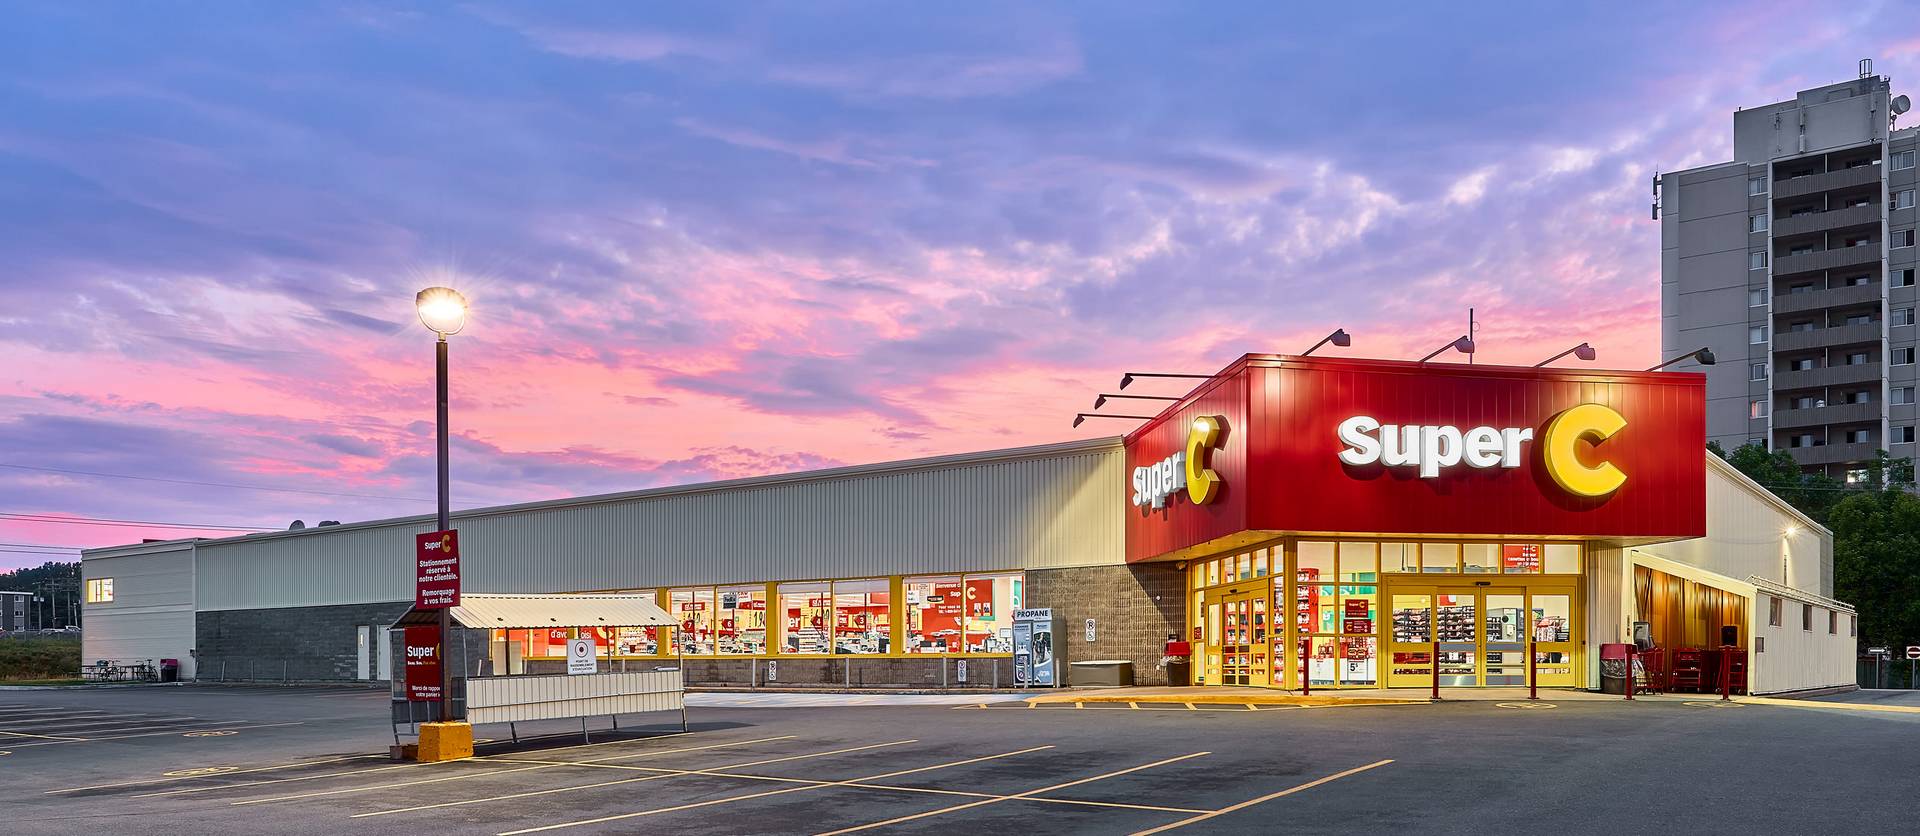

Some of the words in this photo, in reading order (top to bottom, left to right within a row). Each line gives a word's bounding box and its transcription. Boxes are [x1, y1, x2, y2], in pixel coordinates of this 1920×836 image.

[1338, 415, 1533, 478] Super
[1544, 403, 1628, 496] C
[1186, 416, 1220, 505] C
[425, 541, 441, 550] Super
[442, 534, 451, 553] C
[419, 557, 457, 567] Stationnement
[422, 588, 455, 597] Remorquage
[1017, 610, 1048, 618] PROPANE
[407, 645, 434, 660] Super
